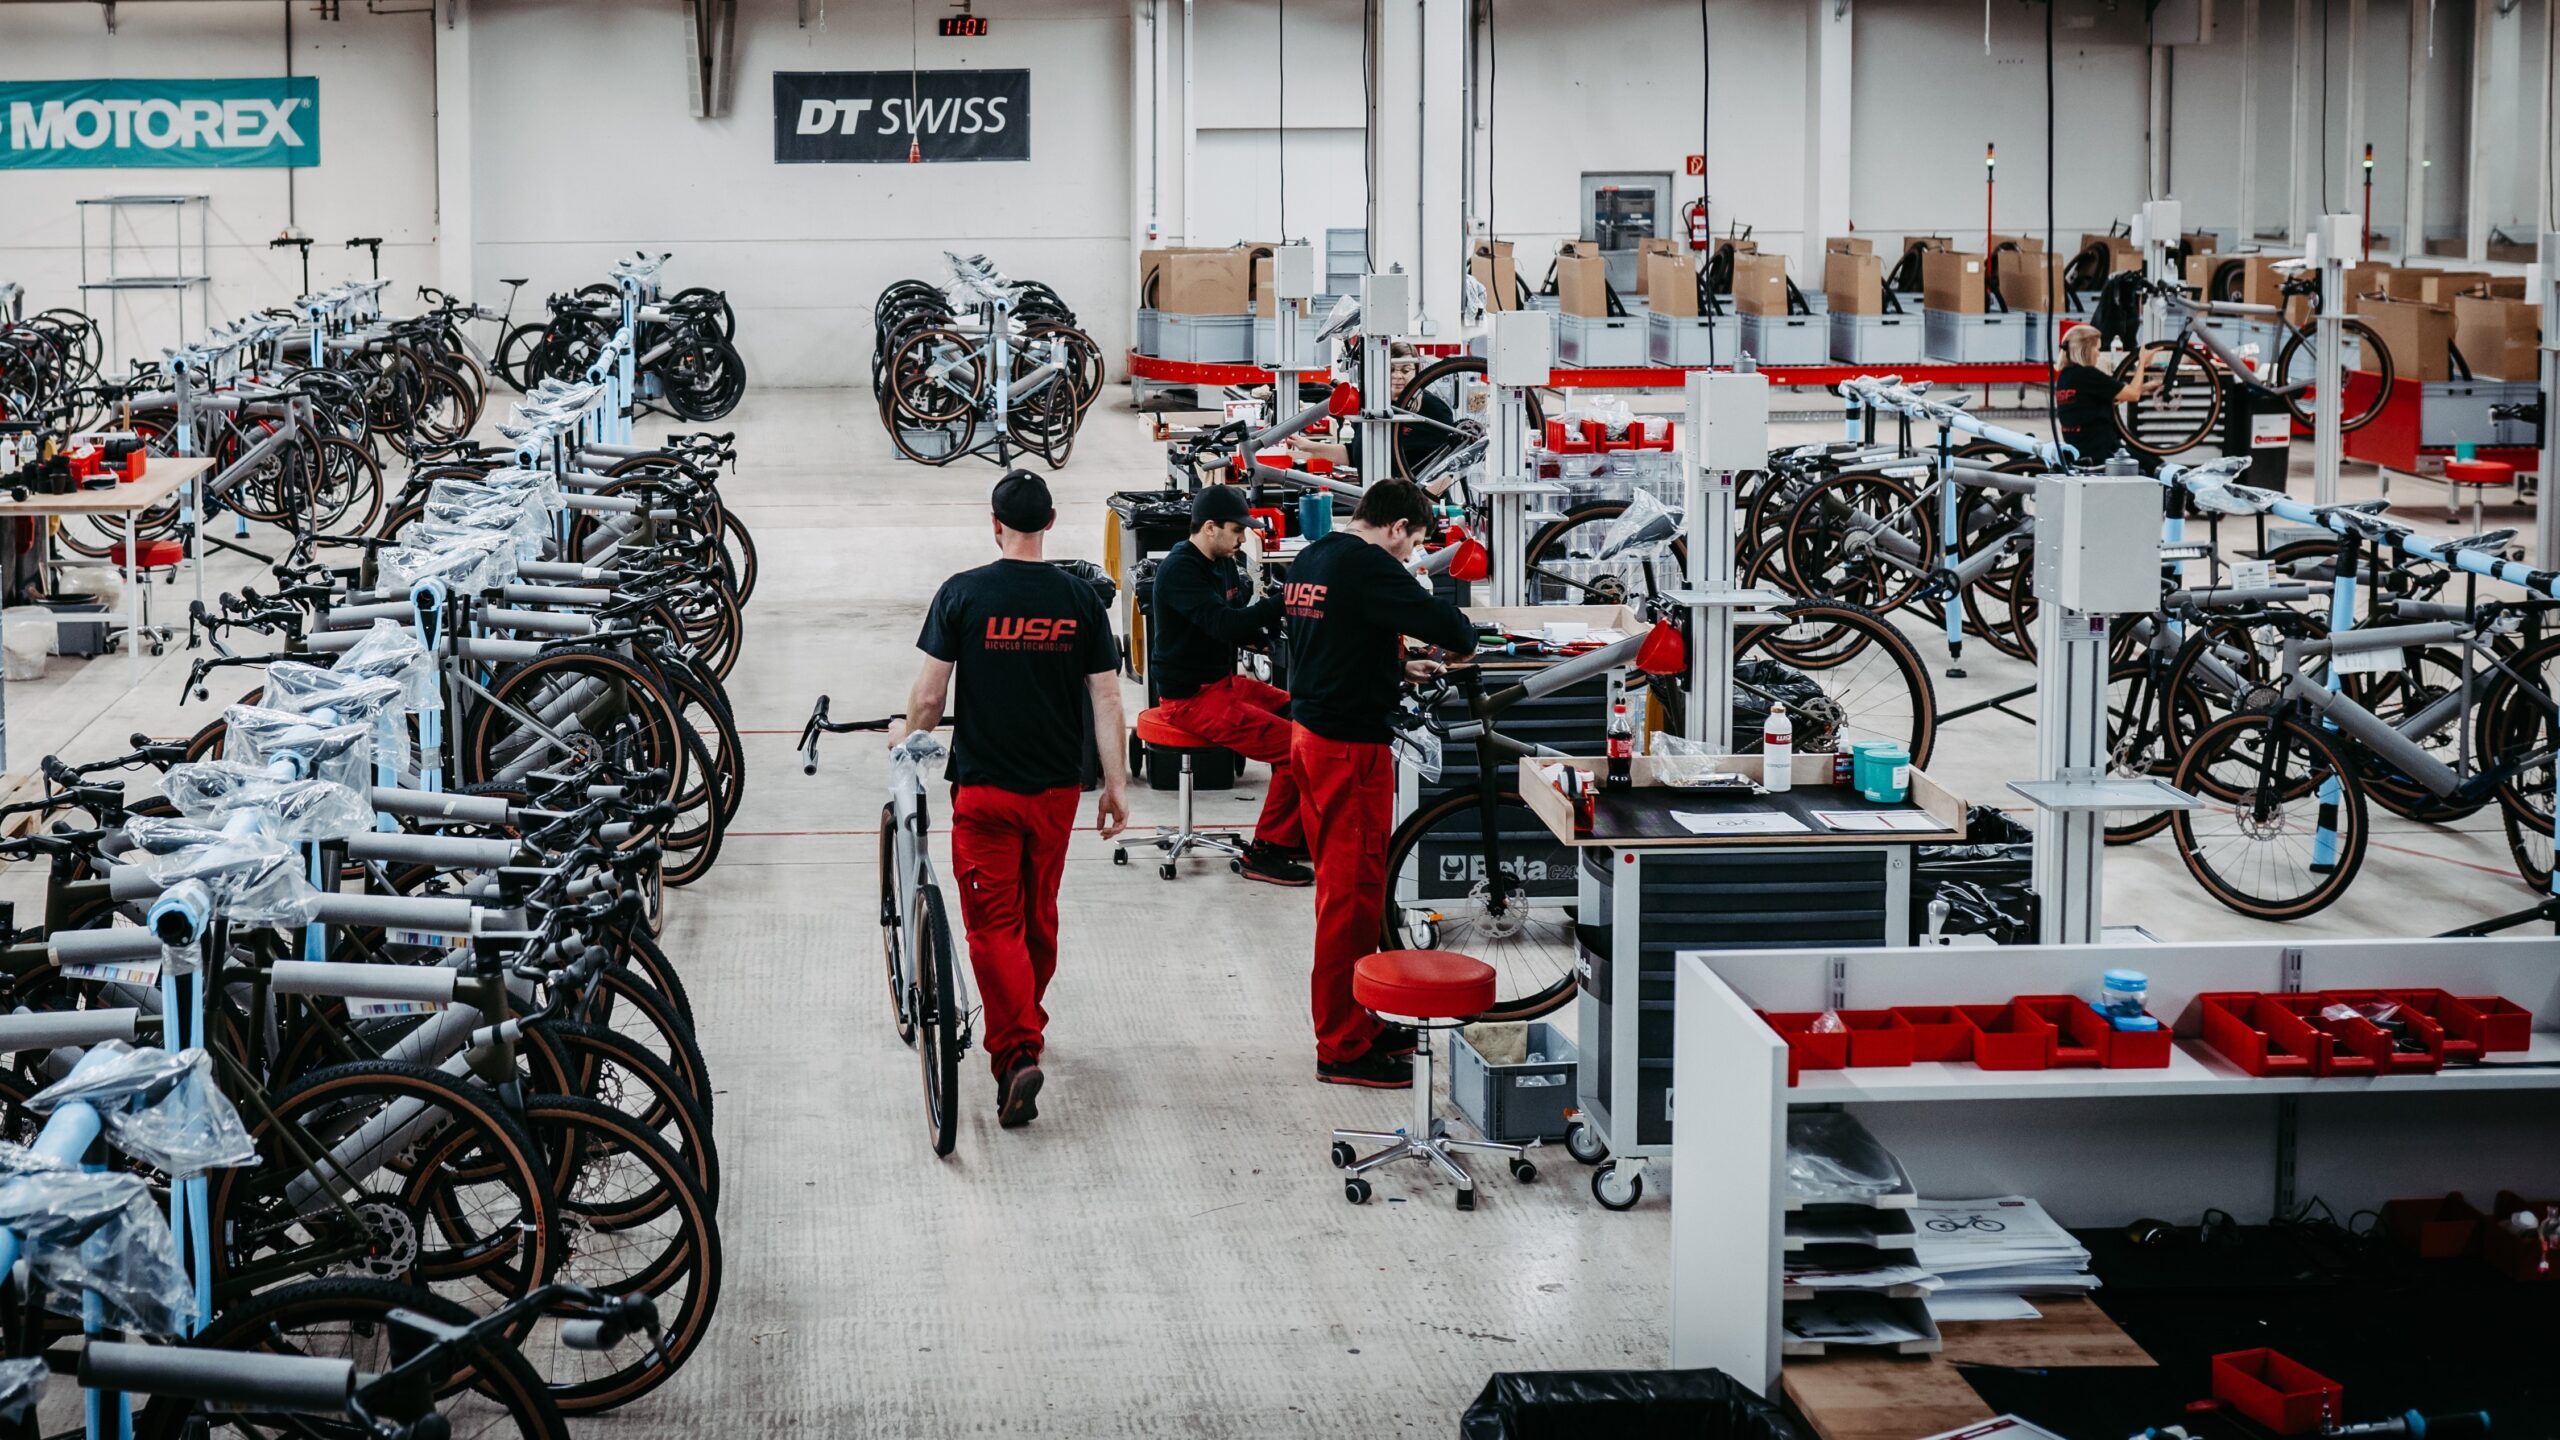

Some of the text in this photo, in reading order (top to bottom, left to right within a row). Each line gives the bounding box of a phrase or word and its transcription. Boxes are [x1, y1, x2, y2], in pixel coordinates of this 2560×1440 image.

[796, 96, 1008, 135] DT SWISS
[986, 616, 1077, 640] WSF
